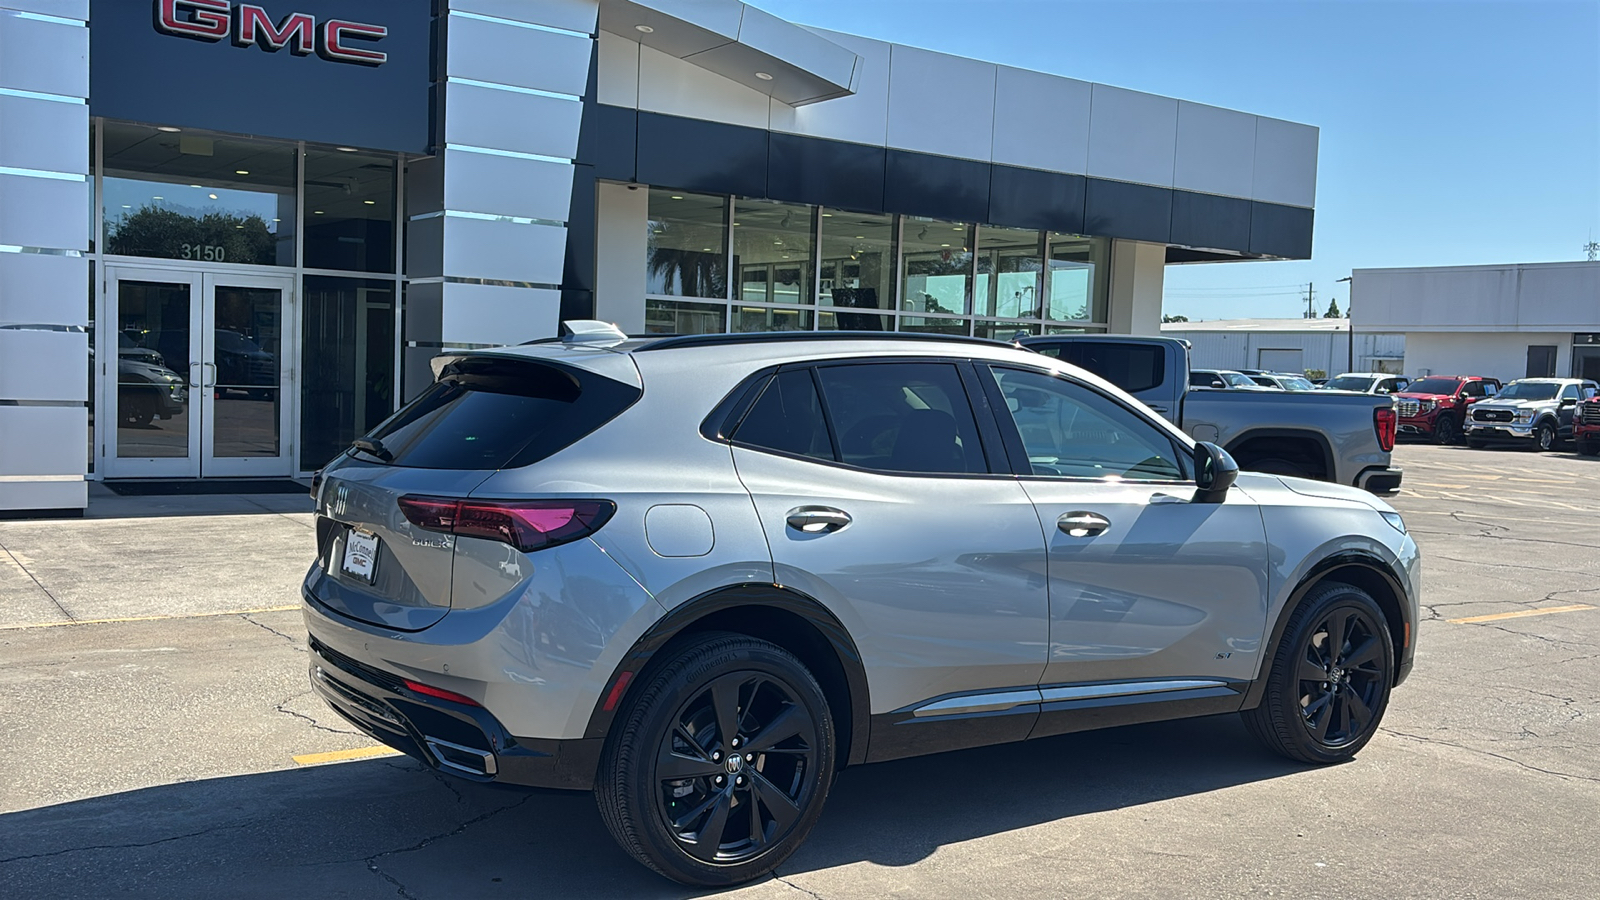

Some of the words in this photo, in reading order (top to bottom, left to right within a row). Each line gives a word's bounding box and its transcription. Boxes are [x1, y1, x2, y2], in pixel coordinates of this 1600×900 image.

[158, 0, 388, 64] GMC
[181, 243, 225, 262] 3150
[352, 557, 367, 568] GMC
[1213, 651, 1235, 660] ST
[686, 653, 731, 683] Continental
